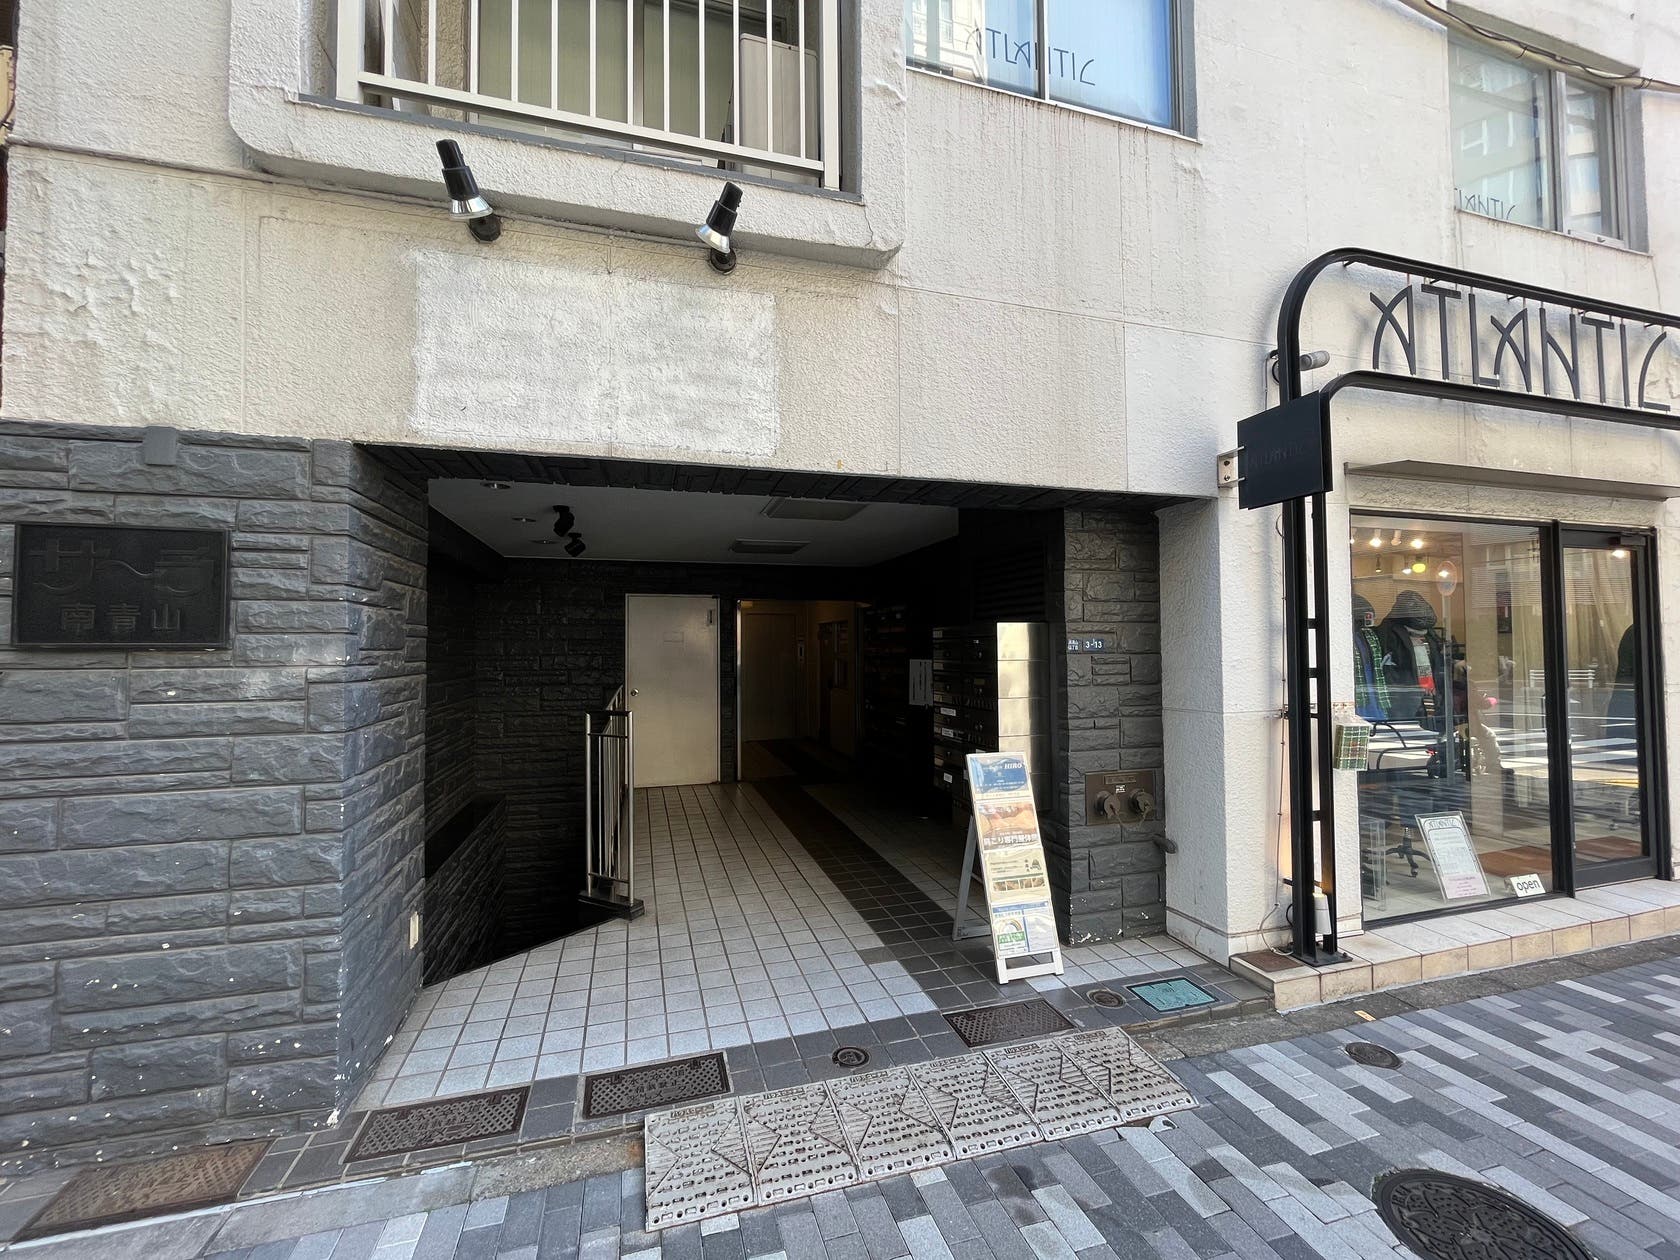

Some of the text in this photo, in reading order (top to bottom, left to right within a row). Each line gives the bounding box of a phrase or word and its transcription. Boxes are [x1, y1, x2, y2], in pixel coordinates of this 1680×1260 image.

[1370, 284, 1671, 412] ATLANTIC
[58, 602, 182, 633] 南青山
[1085, 641, 1103, 649] 3-13
[1516, 879, 1541, 894] open
